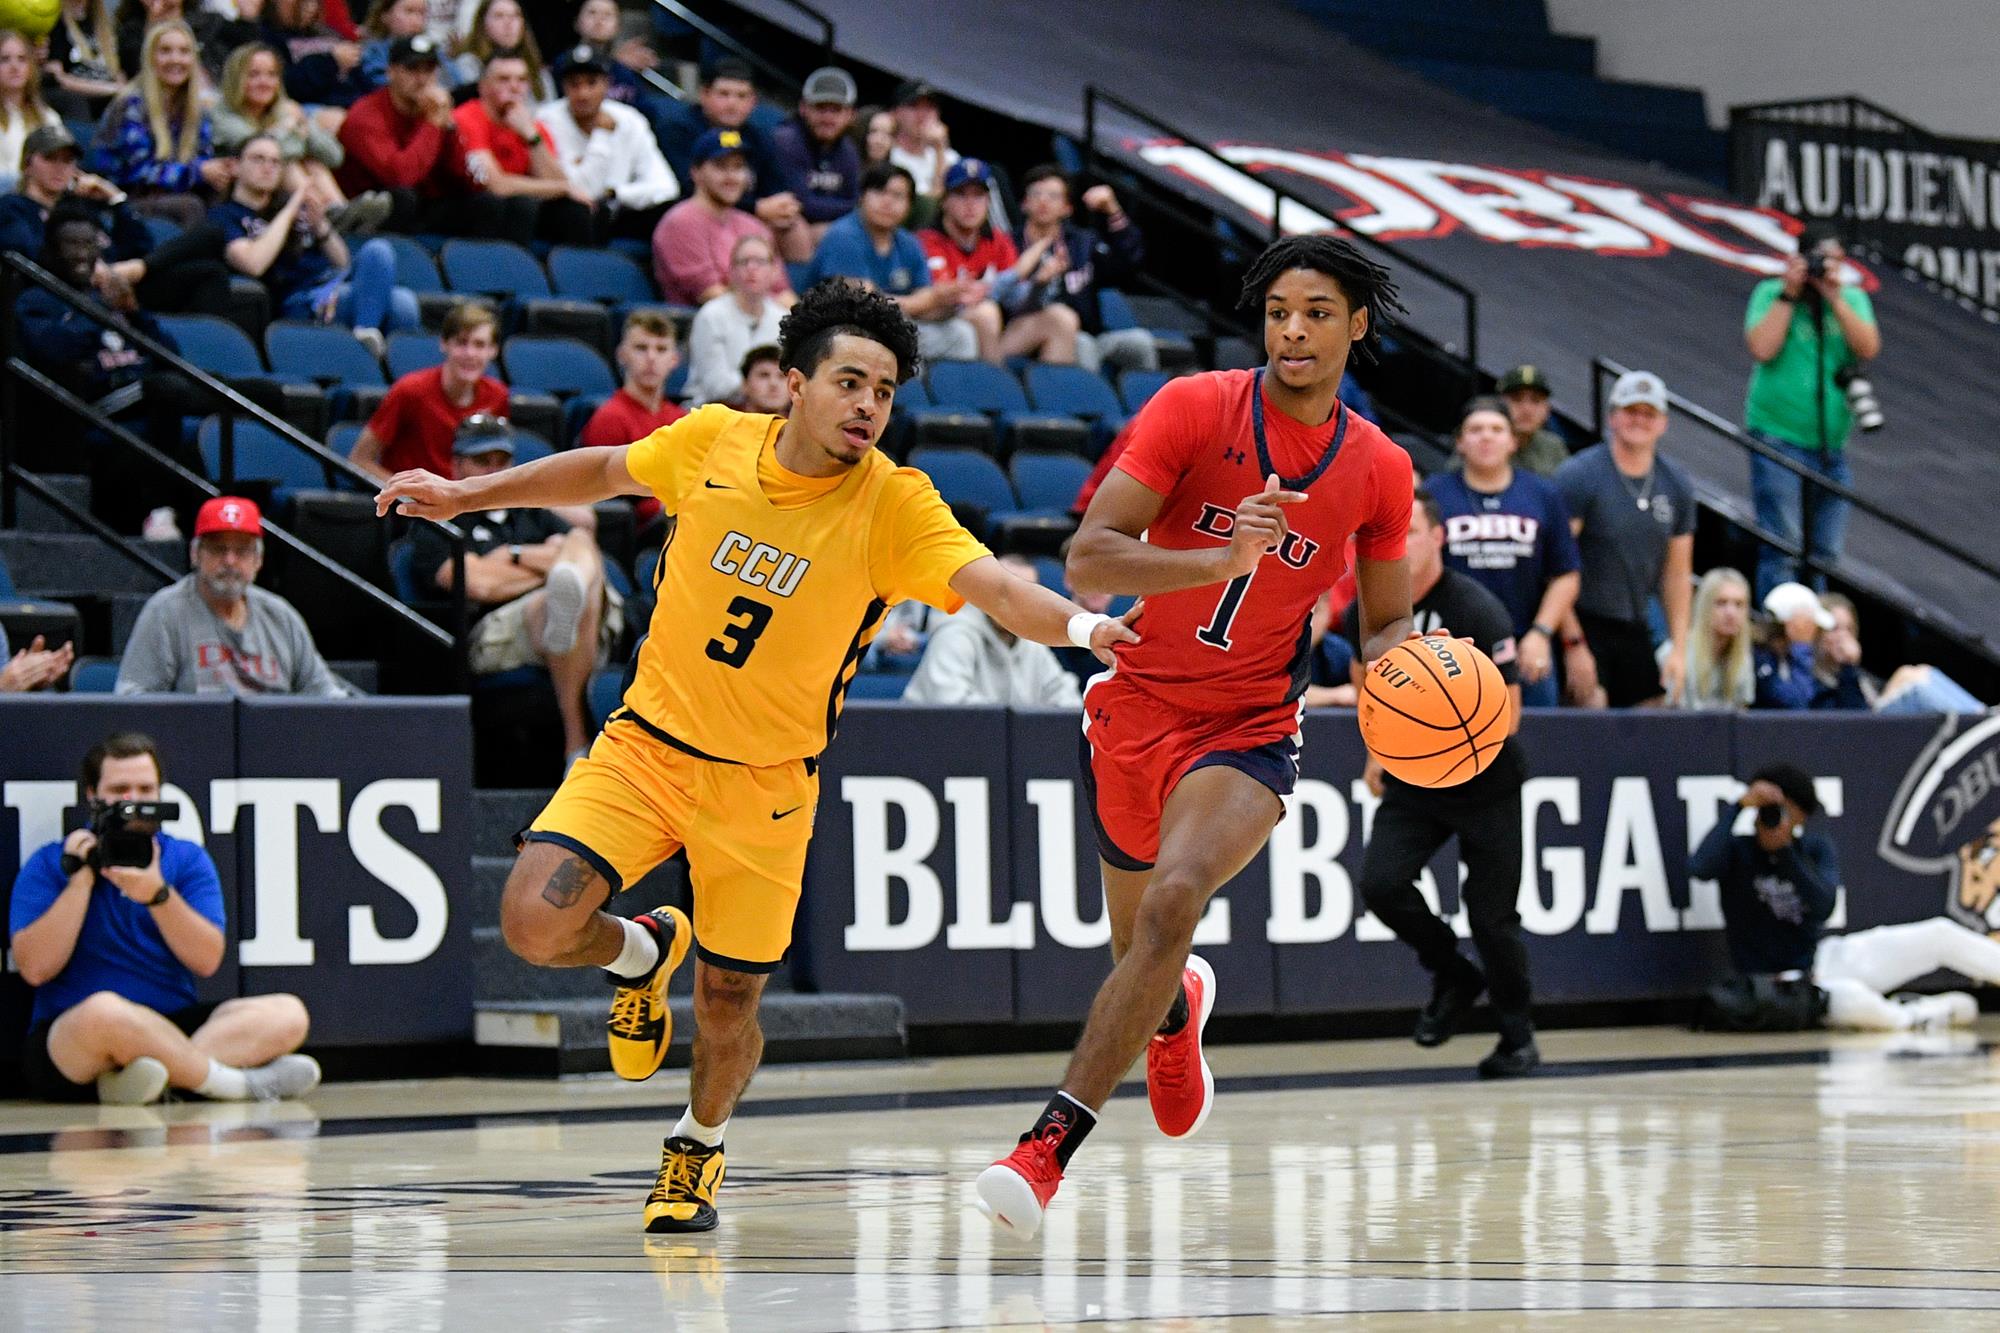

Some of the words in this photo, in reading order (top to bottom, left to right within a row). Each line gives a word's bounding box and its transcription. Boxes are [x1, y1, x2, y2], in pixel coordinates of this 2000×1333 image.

[1757, 138, 2000, 231] AUDIEN
[710, 530, 811, 598] CCU
[1192, 502, 1320, 570] DU
[705, 596, 773, 669] 3
[1195, 563, 1258, 652] 1
[1374, 658, 1411, 688] EVO
[841, 775, 1231, 951] BLU
